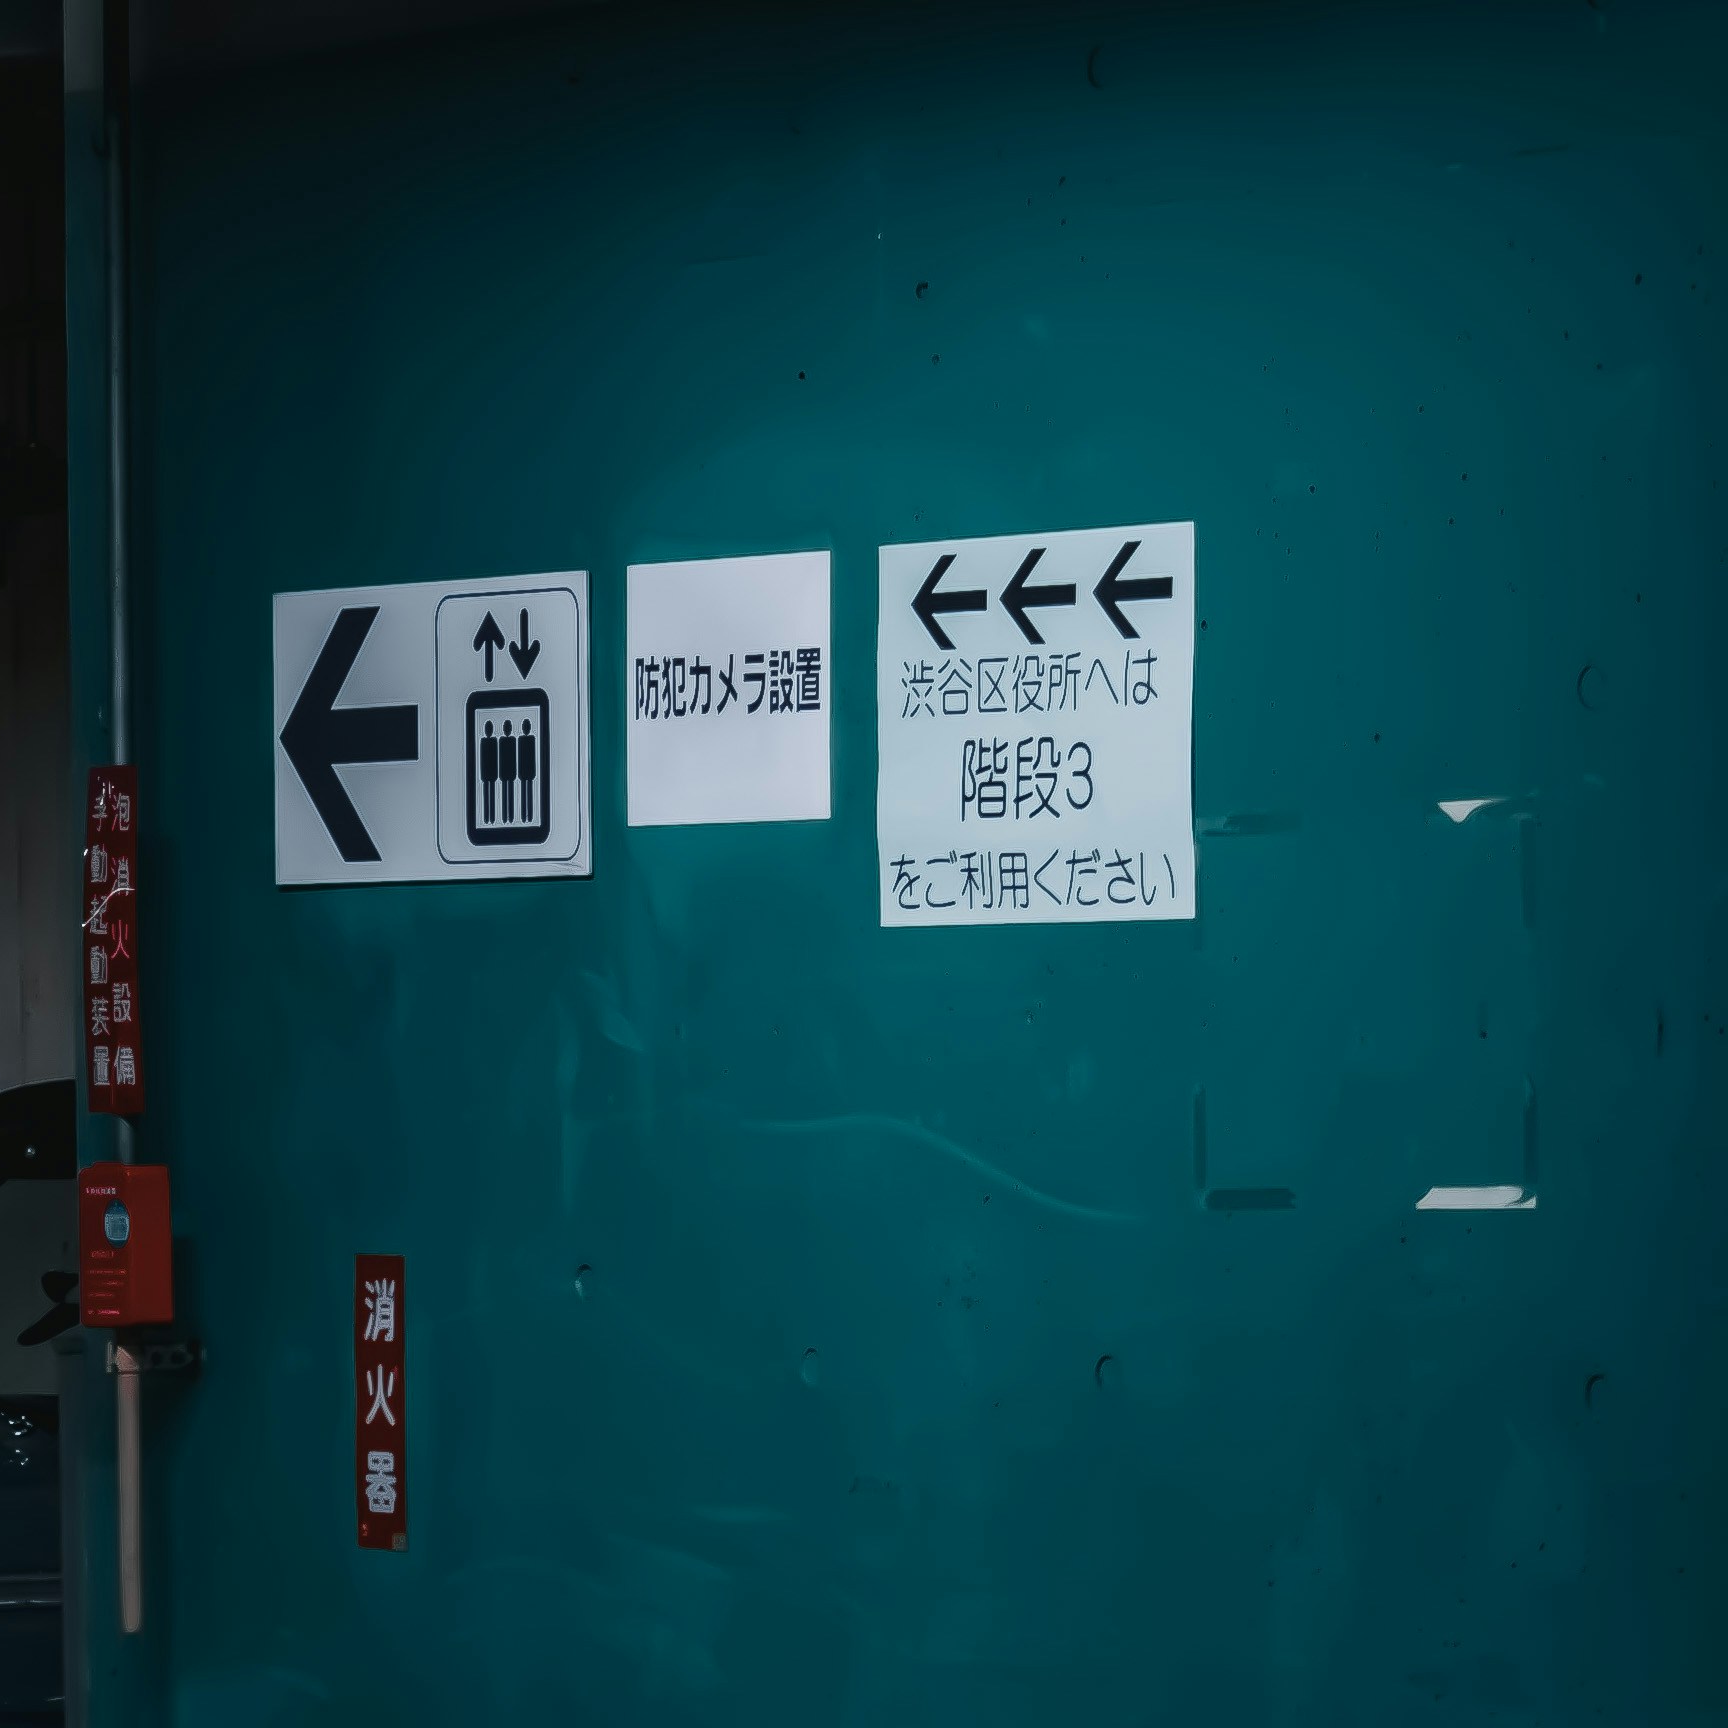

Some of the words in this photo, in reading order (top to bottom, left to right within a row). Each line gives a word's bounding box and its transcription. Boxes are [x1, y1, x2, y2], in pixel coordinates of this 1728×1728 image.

[635, 647, 821, 721] 防犯カメラ設置
[901, 650, 1158, 718] 渋谷区役所へは
[961, 736, 1094, 822] 階段3
[890, 848, 1176, 909] をご利用ください
[364, 1278, 397, 1514] 消火器
